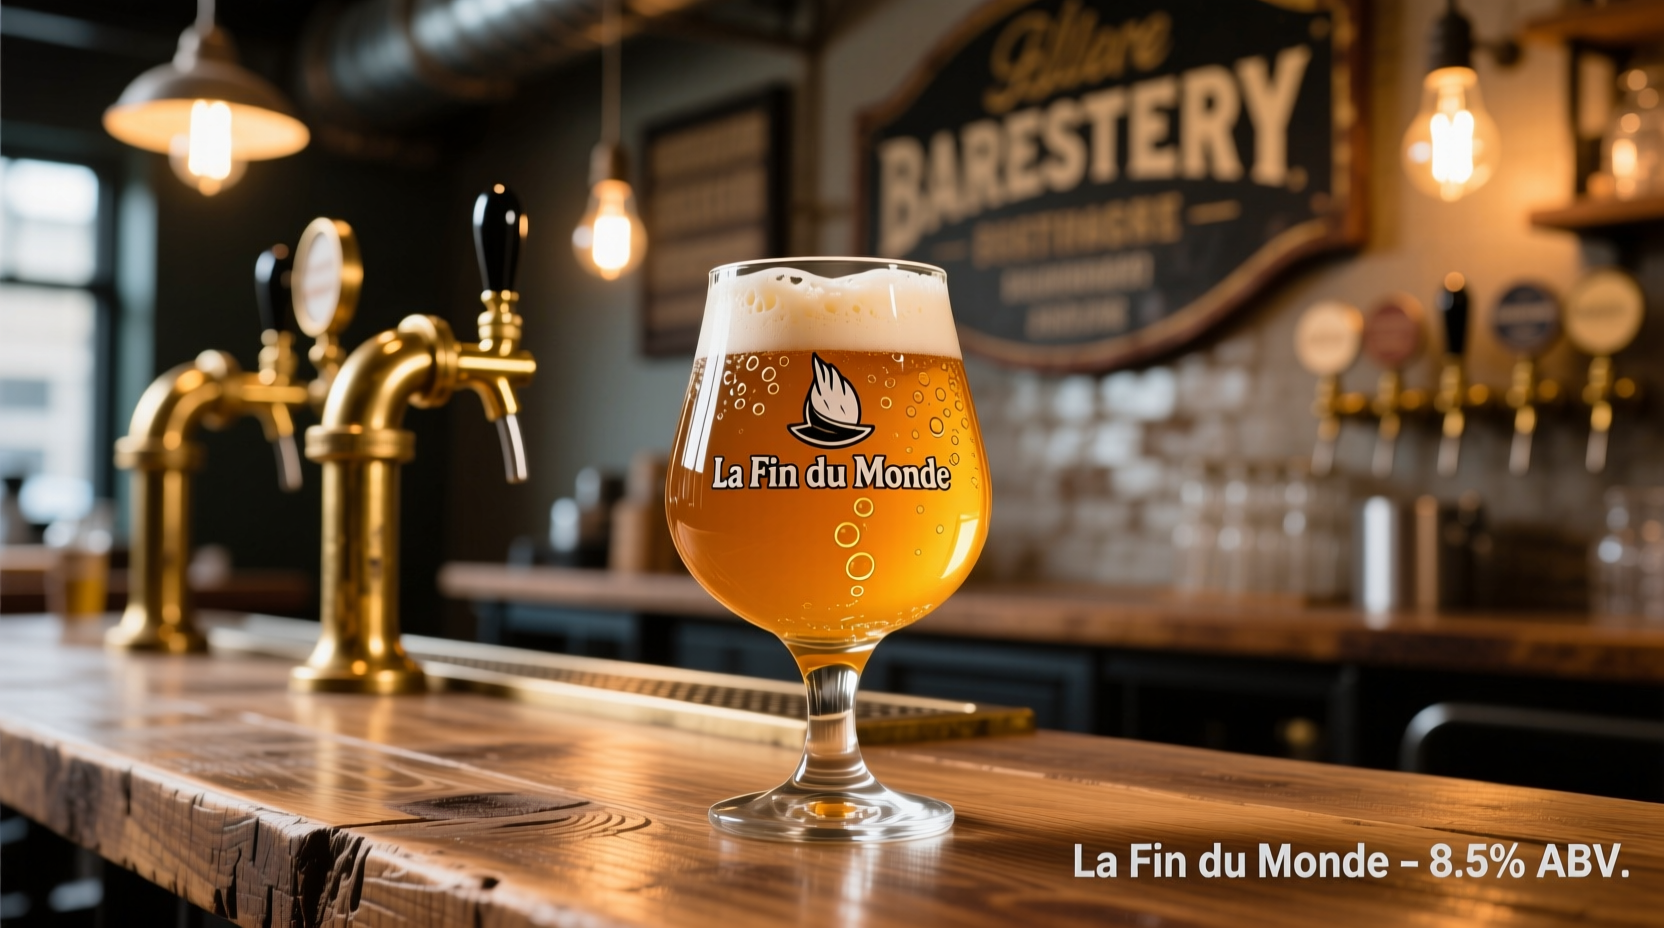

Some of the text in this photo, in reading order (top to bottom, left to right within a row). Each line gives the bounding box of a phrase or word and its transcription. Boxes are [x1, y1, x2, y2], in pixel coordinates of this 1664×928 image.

[878, 45, 1311, 257] BARESTERY
[712, 454, 951, 491] La Fin du Monde
